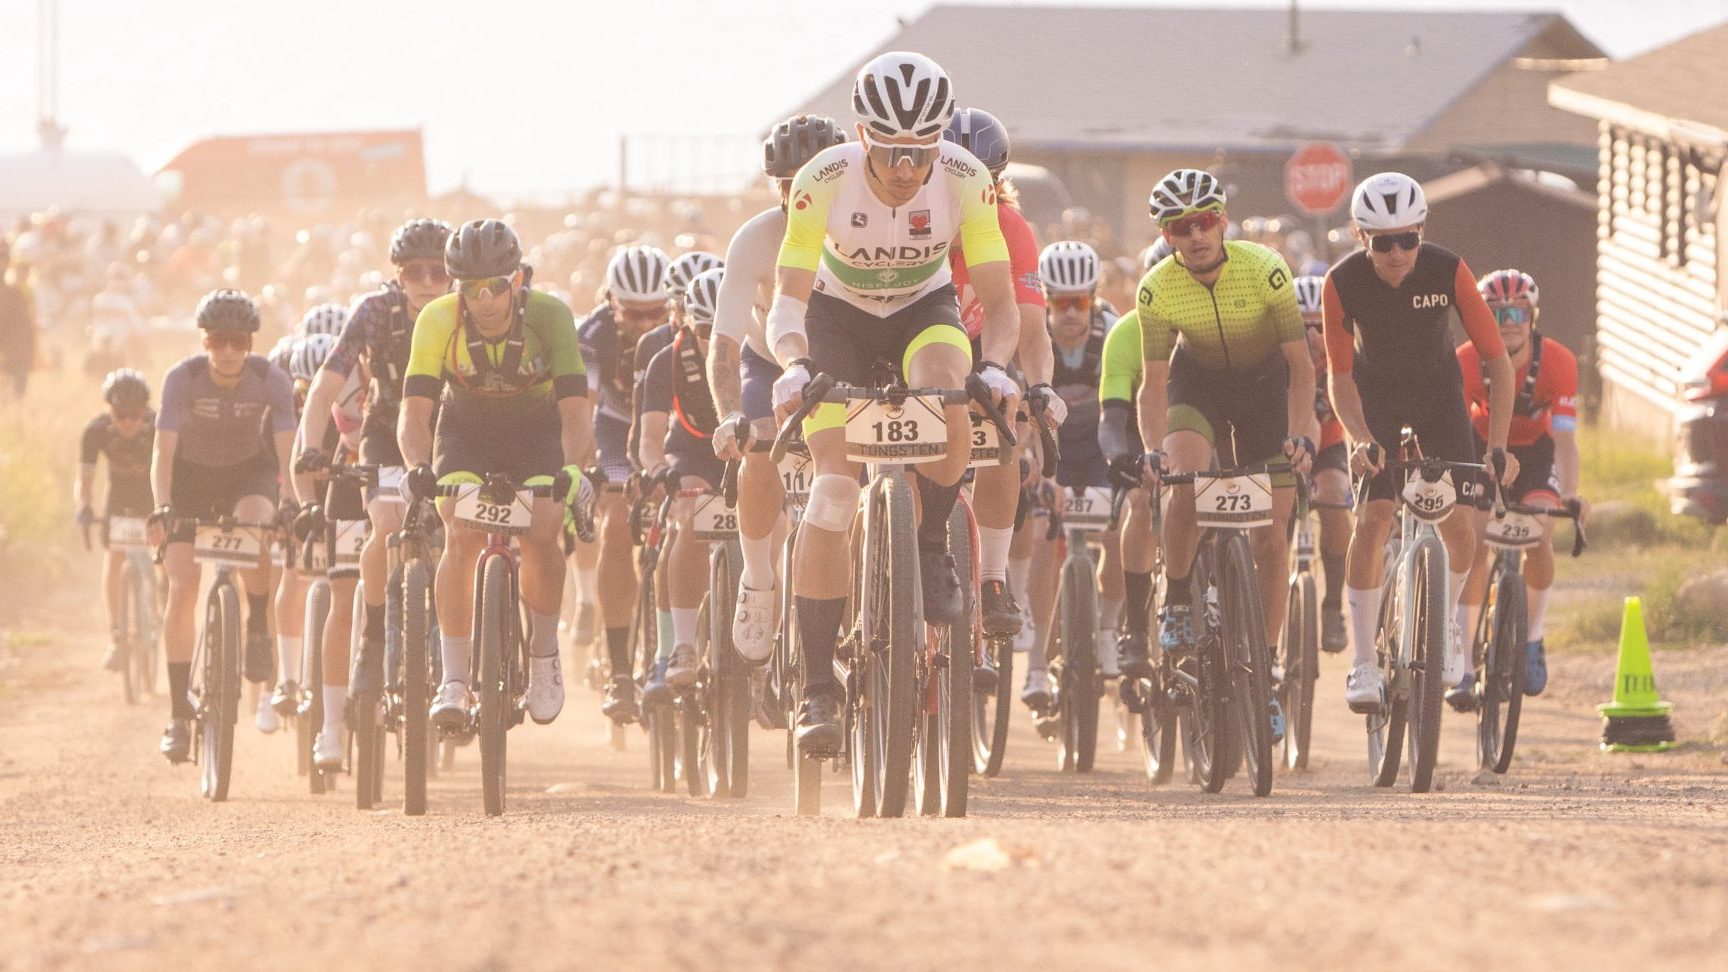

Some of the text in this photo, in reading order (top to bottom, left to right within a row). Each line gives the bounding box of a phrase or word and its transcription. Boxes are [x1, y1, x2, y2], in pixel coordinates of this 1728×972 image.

[812, 158, 849, 182] LANDIS
[940, 155, 977, 178] LANDIS
[1294, 163, 1346, 192] STOP
[834, 241, 948, 261] LANDIS
[1413, 294, 1448, 309] CAPO
[872, 420, 918, 442] 183
[859, 443, 938, 457] TUNGSTEN
[783, 471, 814, 491] 11
[1066, 498, 1094, 513] 287
[1216, 494, 1251, 511] 273
[1414, 493, 1444, 511] 295
[475, 503, 512, 524] 292
[713, 514, 737, 530] 28
[212, 535, 242, 550] 277
